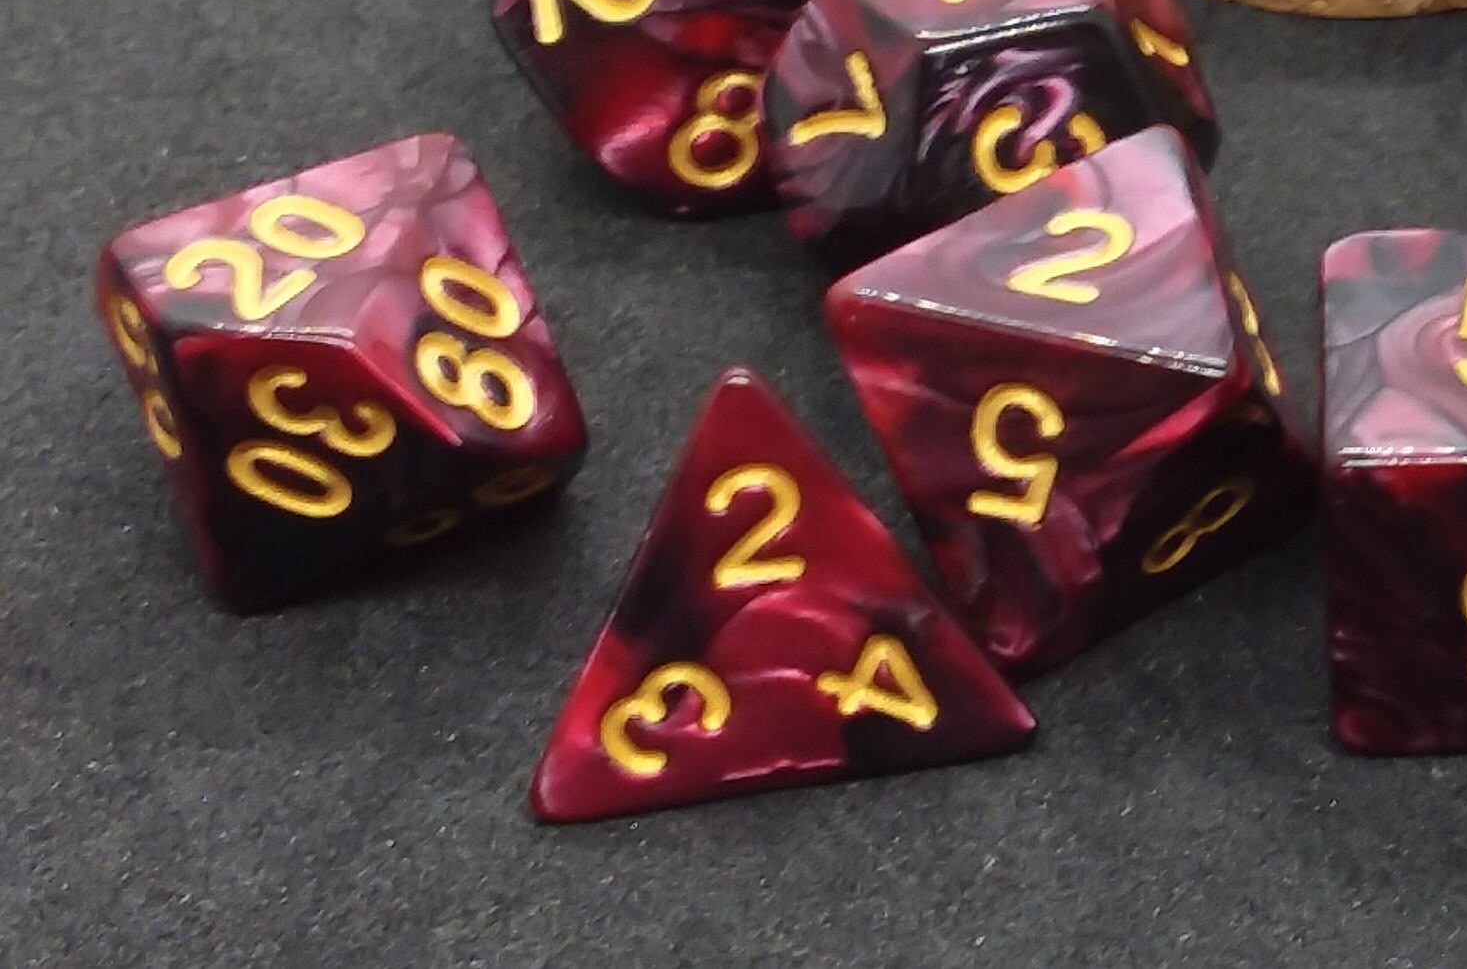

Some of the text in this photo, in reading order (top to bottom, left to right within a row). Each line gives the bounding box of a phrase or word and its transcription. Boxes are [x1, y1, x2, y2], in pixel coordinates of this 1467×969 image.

[668, 71, 761, 189] 8
[789, 50, 886, 145] 7
[165, 195, 366, 320] 20
[1006, 209, 1134, 303] 2
[414, 255, 536, 431] 80
[226, 366, 397, 518] 30
[967, 383, 1065, 530] 5
[706, 463, 807, 590] 2
[1141, 476, 1255, 574] 8
[600, 661, 731, 778] 3
[817, 634, 939, 730] 4
